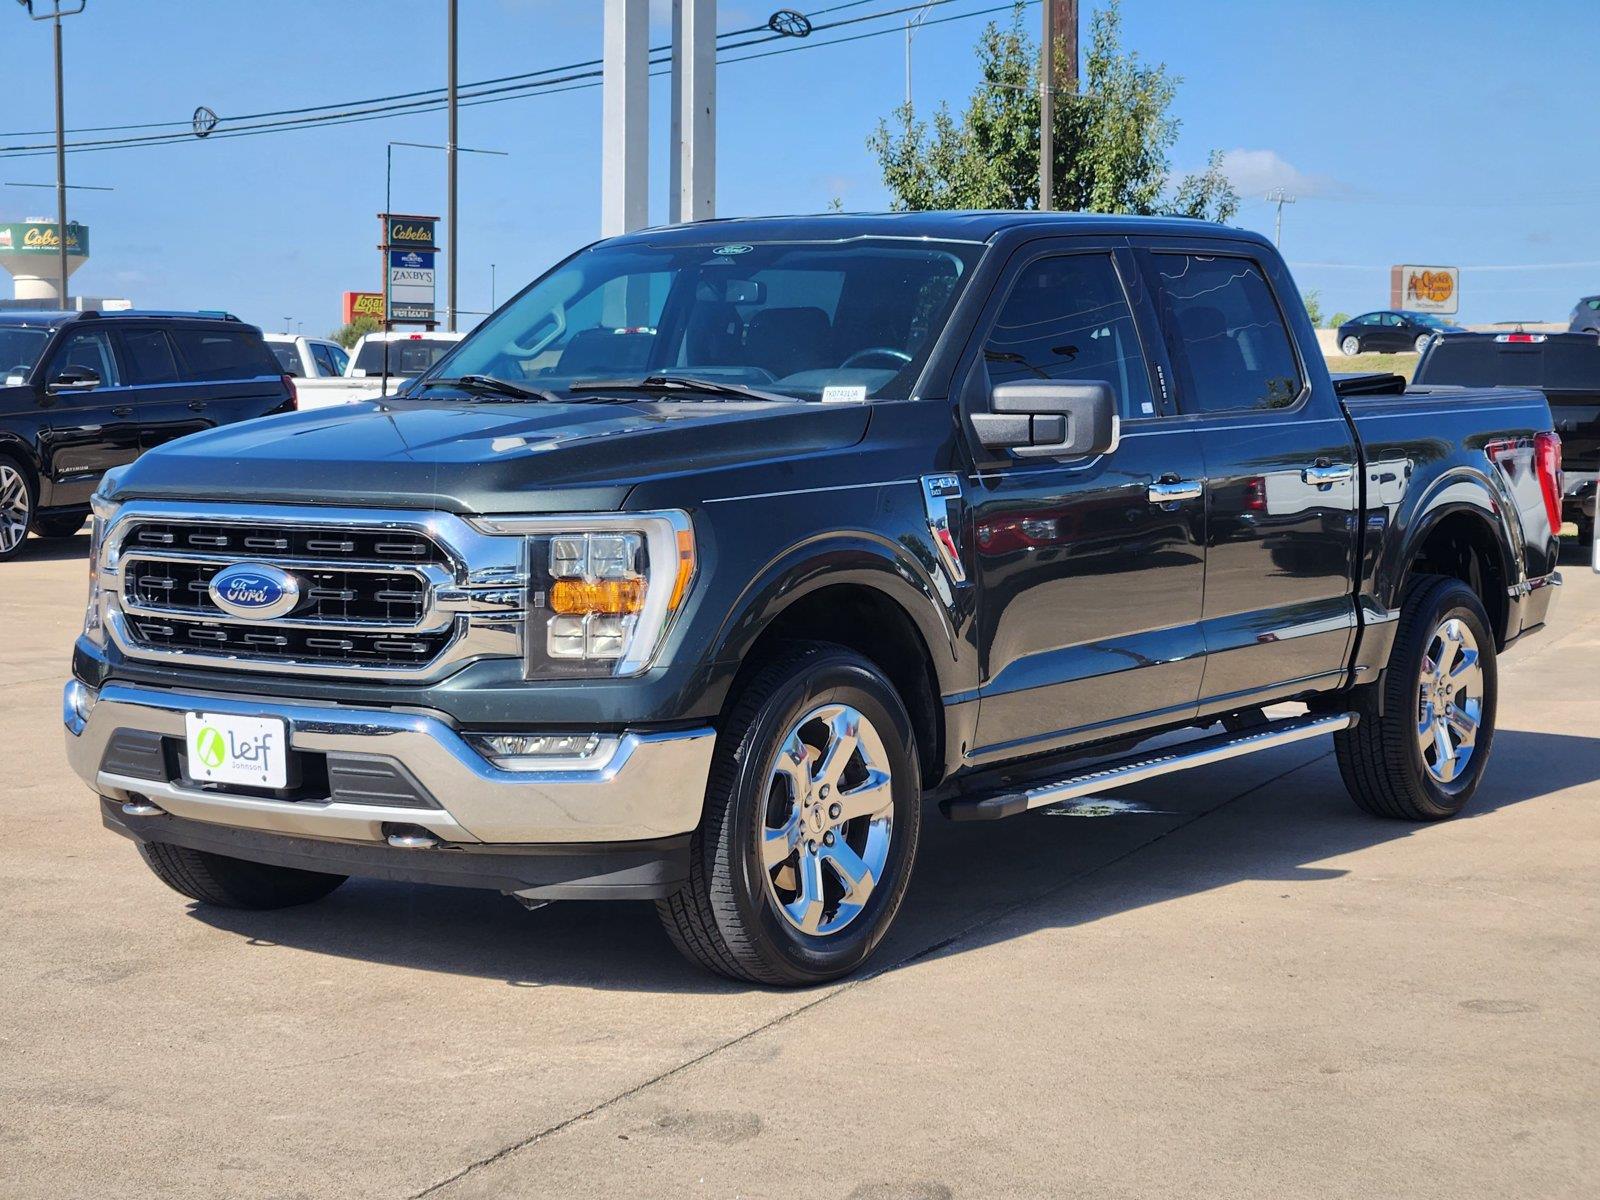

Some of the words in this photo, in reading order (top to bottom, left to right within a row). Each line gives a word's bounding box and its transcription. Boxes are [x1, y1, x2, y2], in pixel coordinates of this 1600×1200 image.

[24, 228, 78, 246] Cabea's
[392, 224, 432, 241] Cabela's
[393, 271, 432, 283] ZAXBY'S
[392, 306, 430, 318] verizon
[58, 465, 89, 473] PLATINUM
[227, 578, 269, 602] Ford
[228, 730, 273, 771] leif
[232, 761, 262, 771] Johnson
